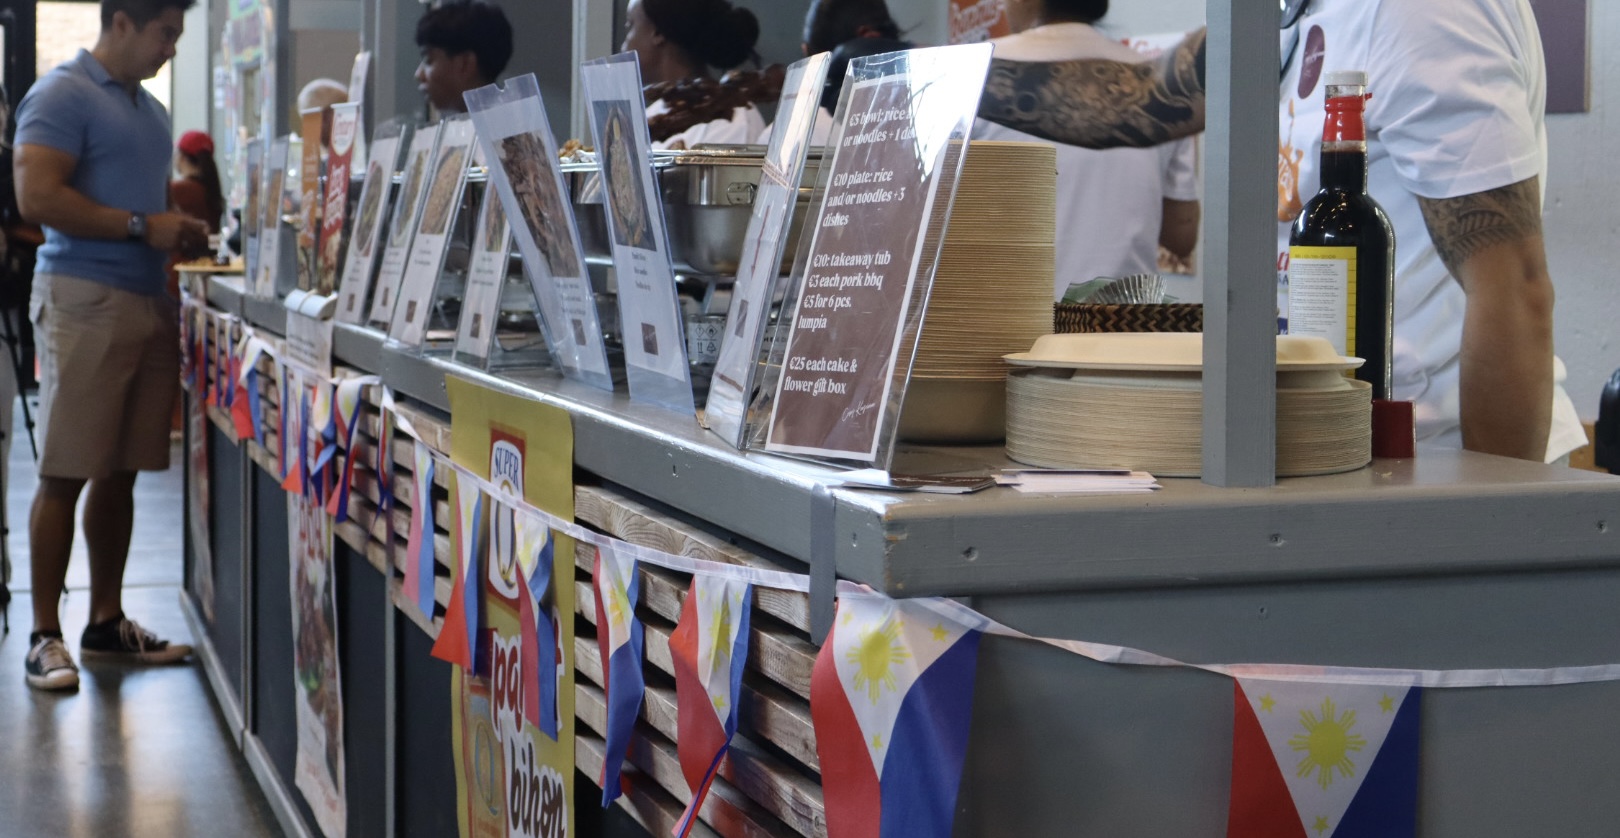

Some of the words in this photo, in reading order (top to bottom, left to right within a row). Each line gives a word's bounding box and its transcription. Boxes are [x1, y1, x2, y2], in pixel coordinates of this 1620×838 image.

[849, 113, 860, 127] €5
[860, 109, 884, 125] bowl:
[884, 106, 906, 121] rice
[843, 136, 853, 147] or
[853, 128, 887, 145] noodles
[895, 128, 901, 141] 1
[833, 172, 848, 187] €10
[847, 170, 872, 189] plate:
[873, 168, 894, 183] rice
[827, 191, 856, 207] and/or
[856, 188, 893, 205] noodles
[898, 187, 906, 201] 3
[822, 211, 850, 227] dishes
[813, 253, 830, 268] €10:
[830, 252, 874, 270] takeaway
[874, 250, 891, 266] tub
[808, 274, 820, 288] €3
[819, 273, 840, 287] each
[839, 272, 864, 291] pork
[863, 272, 884, 291] bbq
[804, 295, 815, 308] €5
[814, 293, 828, 308] for
[828, 294, 835, 308] 6
[833, 295, 852, 312] pcs.
[798, 314, 828, 333] lumpia
[789, 356, 806, 371] €25
[806, 357, 827, 371] each
[826, 357, 850, 373] cake
[849, 358, 858, 373] &
[783, 376, 813, 393] flower
[812, 377, 828, 397] gift
[827, 378, 847, 395] box
[493, 447, 519, 491] SUPER
[510, 736, 565, 838] bihon
